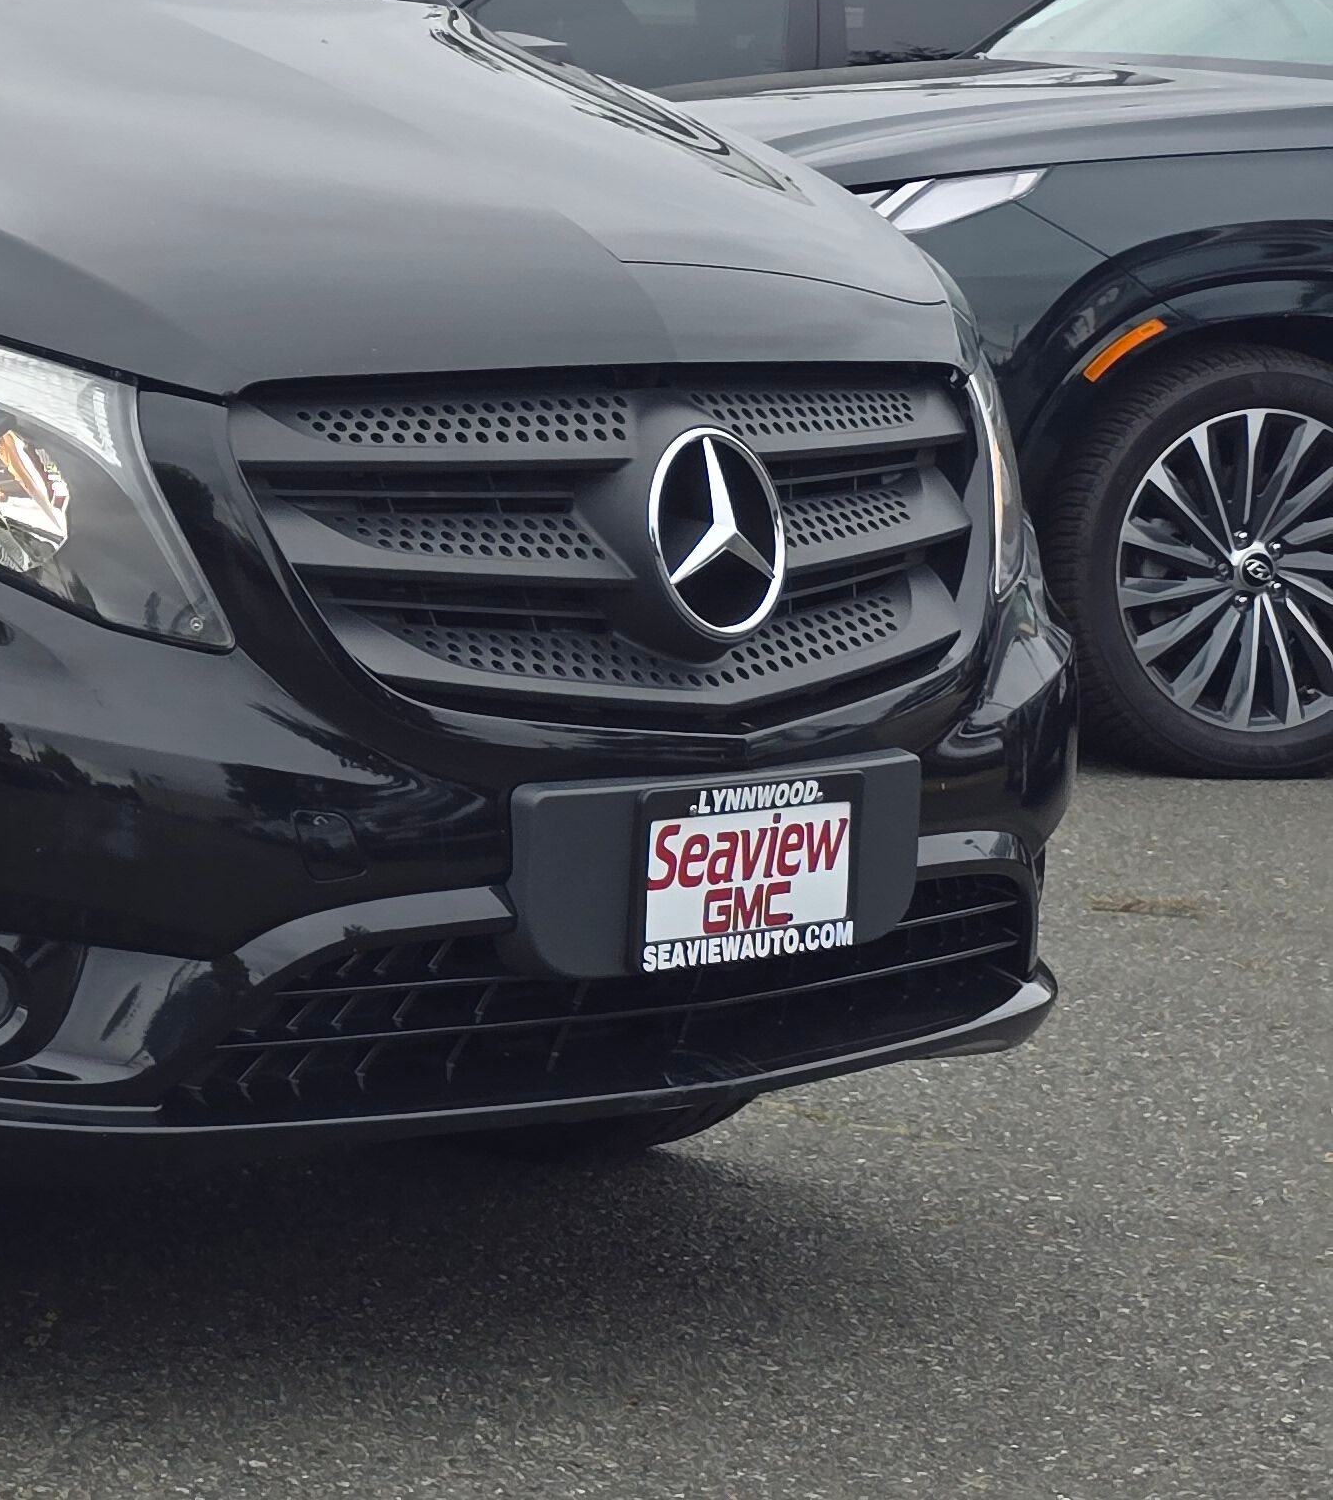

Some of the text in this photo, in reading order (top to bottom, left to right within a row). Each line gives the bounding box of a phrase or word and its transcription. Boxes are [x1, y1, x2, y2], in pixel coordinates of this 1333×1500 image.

[698, 780, 819, 814] LYNNWOOD
[646, 813, 848, 891] Seaview
[702, 881, 793, 934] GMC
[643, 921, 854, 972] SEAVIEWAUTO.COM
